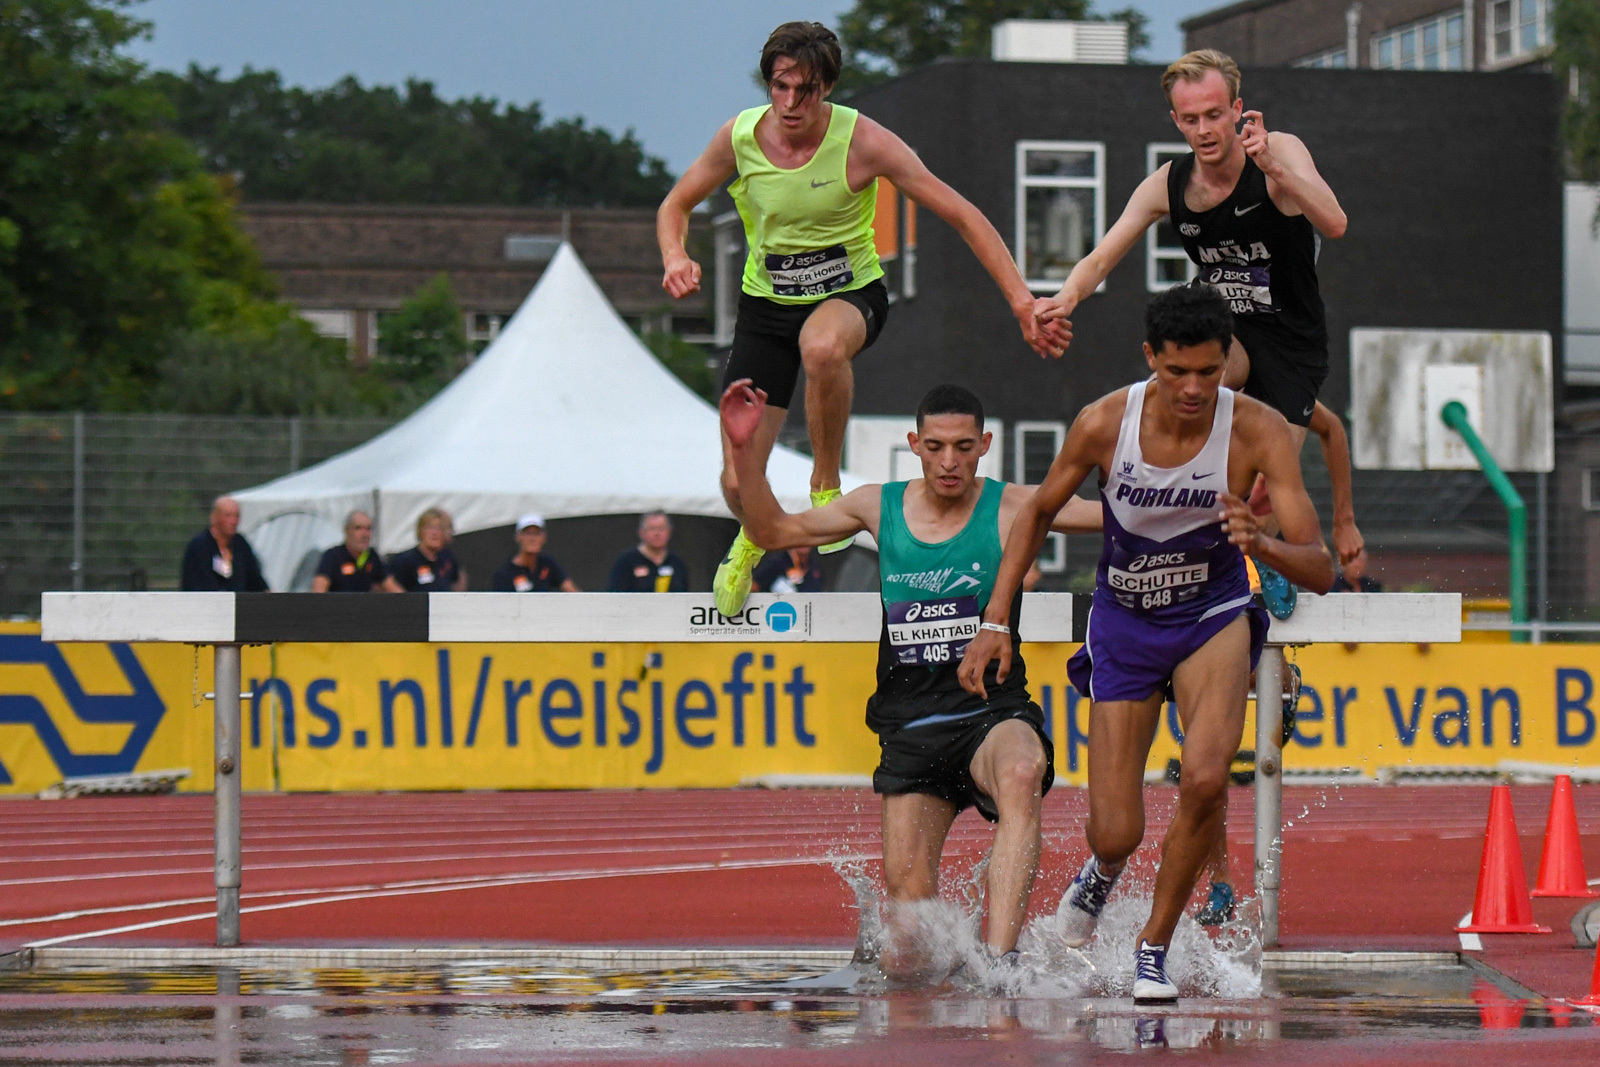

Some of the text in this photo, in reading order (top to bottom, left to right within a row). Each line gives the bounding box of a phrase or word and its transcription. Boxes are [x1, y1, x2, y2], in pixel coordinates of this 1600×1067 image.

[1197, 241, 1272, 264] MILA
[814, 261, 848, 279] HORST
[1223, 270, 1251, 283] asics
[800, 283, 826, 297] 358
[1223, 287, 1255, 299] UTZ
[1230, 300, 1255, 314] 484
[1116, 483, 1218, 509] PORTLAND
[1147, 552, 1186, 568] asics
[886, 566, 954, 584] ROTTERDAM
[1112, 569, 1202, 590] SCHUTTE
[1142, 589, 1172, 610] 648
[922, 602, 957, 618] asics
[891, 631, 909, 642] EL
[912, 623, 978, 640] KHATTABI
[923, 643, 951, 663] 405
[250, 649, 816, 773] ns.nl/reisjefit
[1384, 686, 1521, 747] van
[1556, 668, 1597, 747] B
